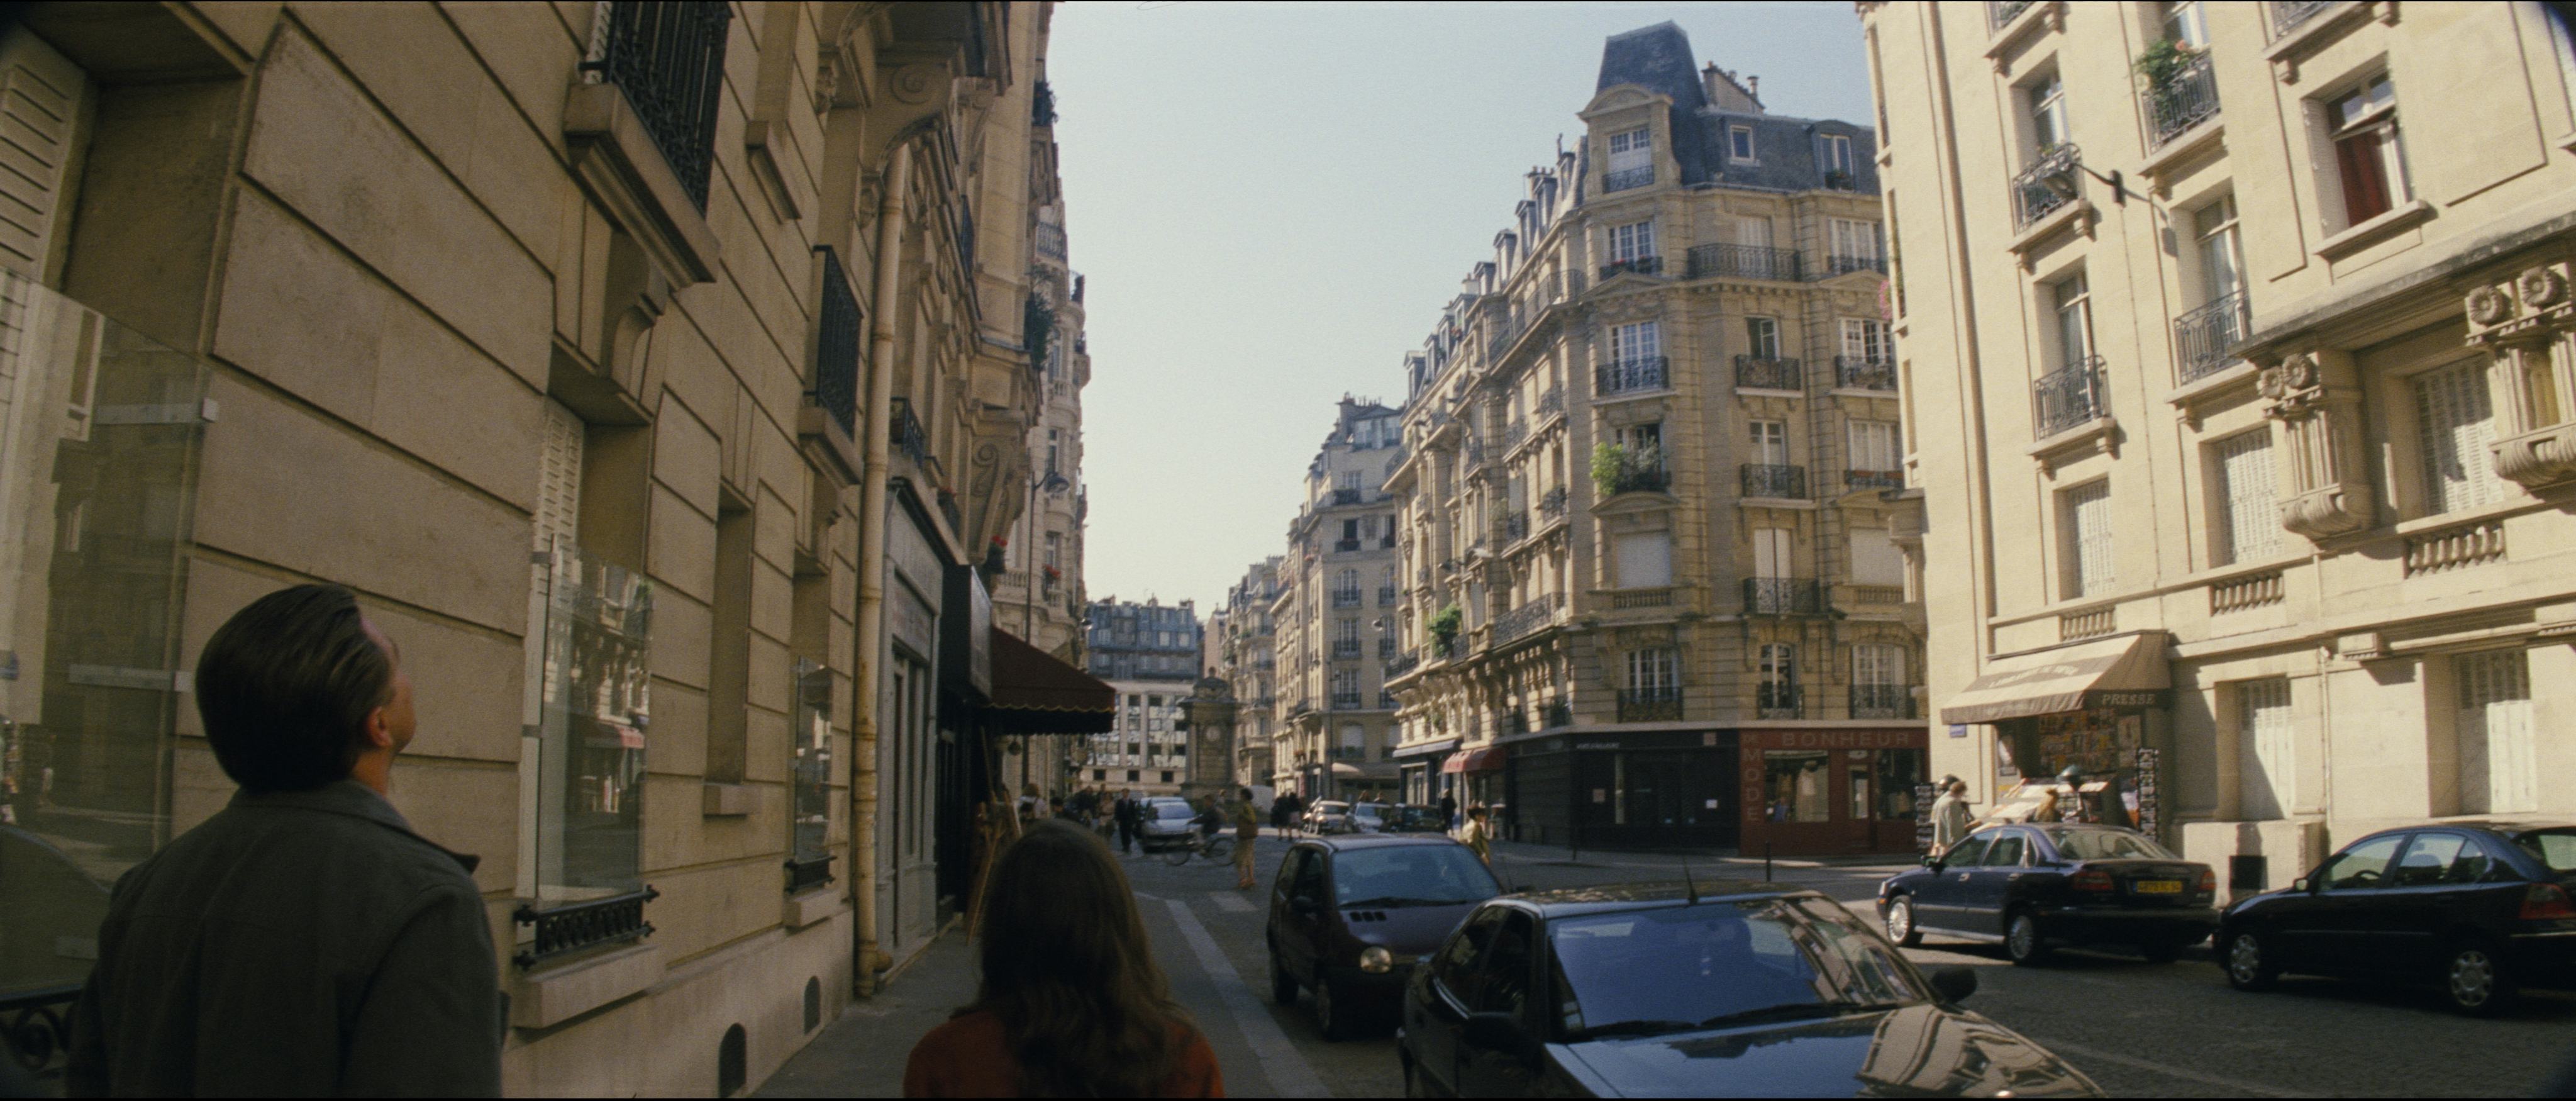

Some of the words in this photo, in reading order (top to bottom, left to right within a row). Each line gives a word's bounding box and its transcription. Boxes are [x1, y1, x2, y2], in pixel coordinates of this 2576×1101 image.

[2102, 693, 2156, 705] PRESSE
[1782, 732, 1909, 747] BONHEUR
[1743, 748, 1762, 822] MODE
